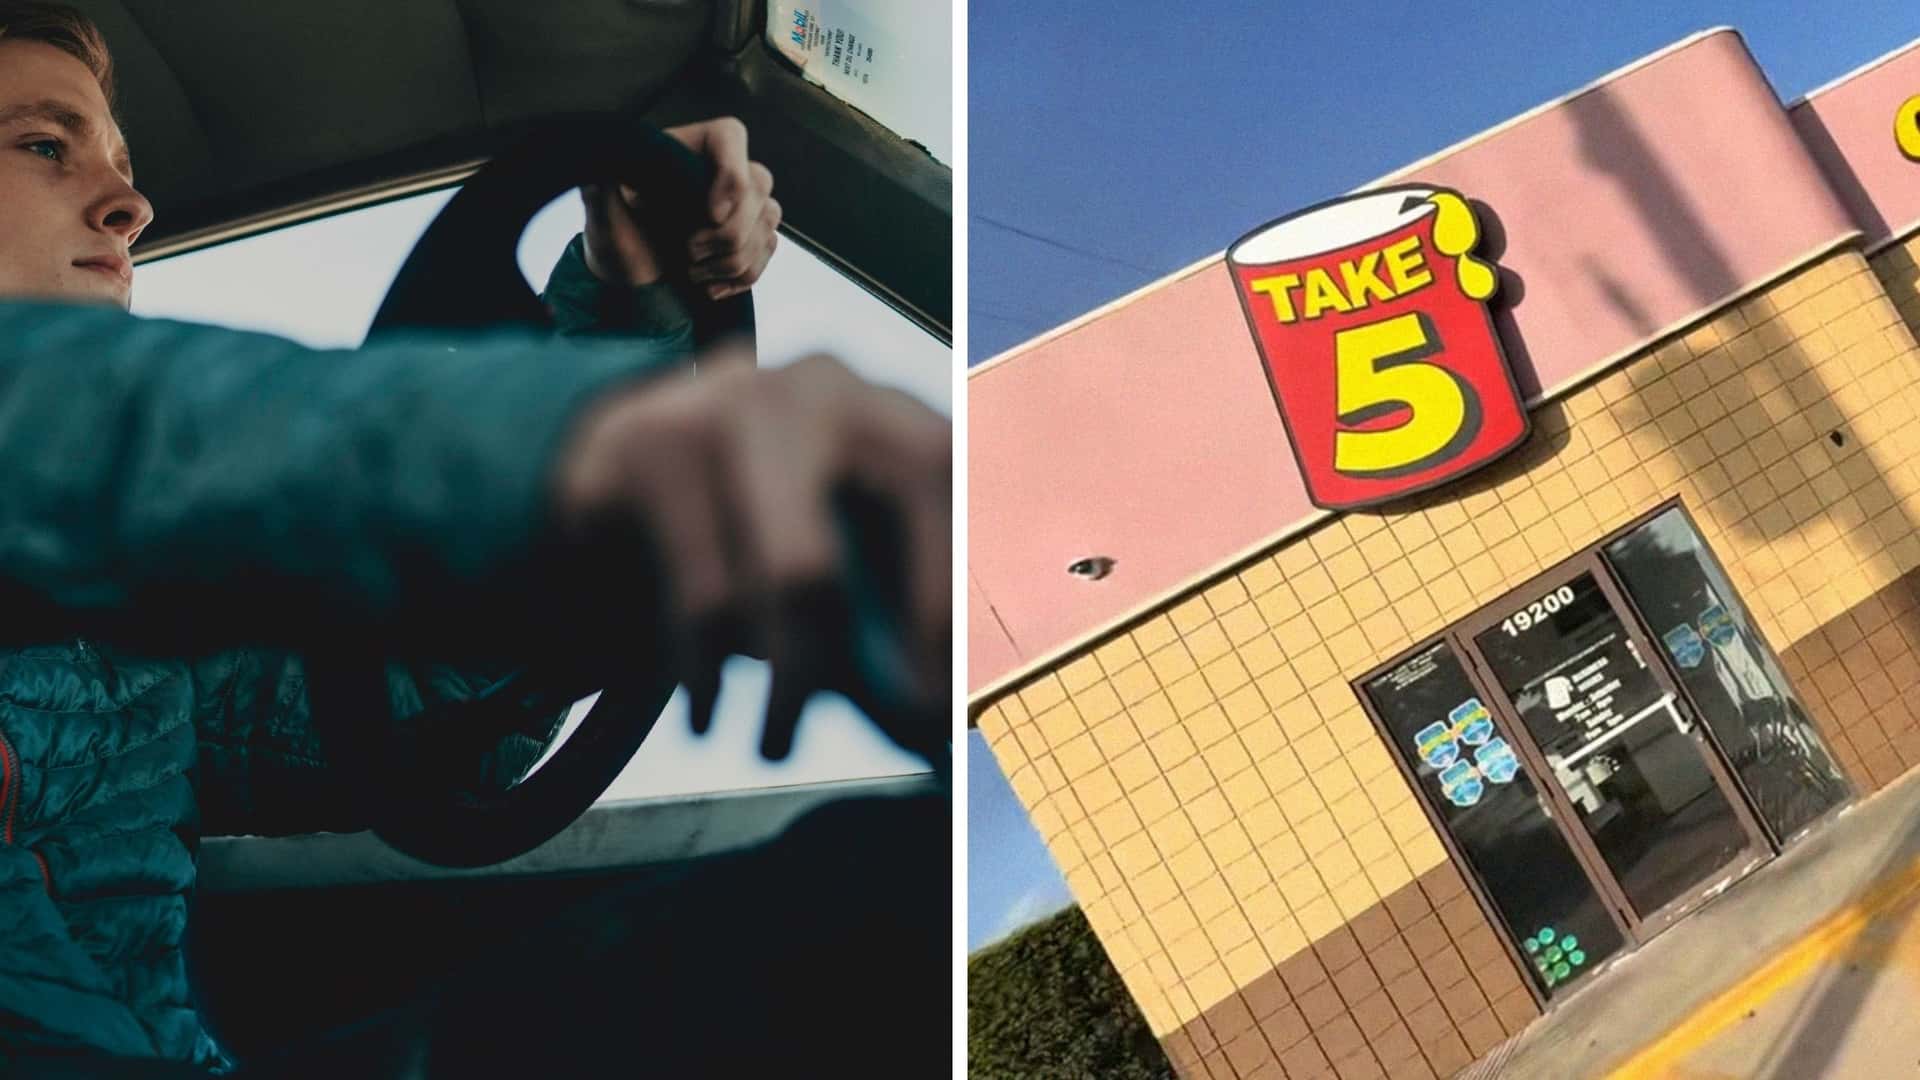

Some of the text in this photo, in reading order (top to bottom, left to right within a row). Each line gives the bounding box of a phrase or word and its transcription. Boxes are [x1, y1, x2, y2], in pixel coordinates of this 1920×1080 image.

[792, 7, 807, 45] Mobil
[1250, 234, 1433, 323] TAKE
[1334, 311, 1474, 476] 5
[1501, 586, 1575, 637] 19200
